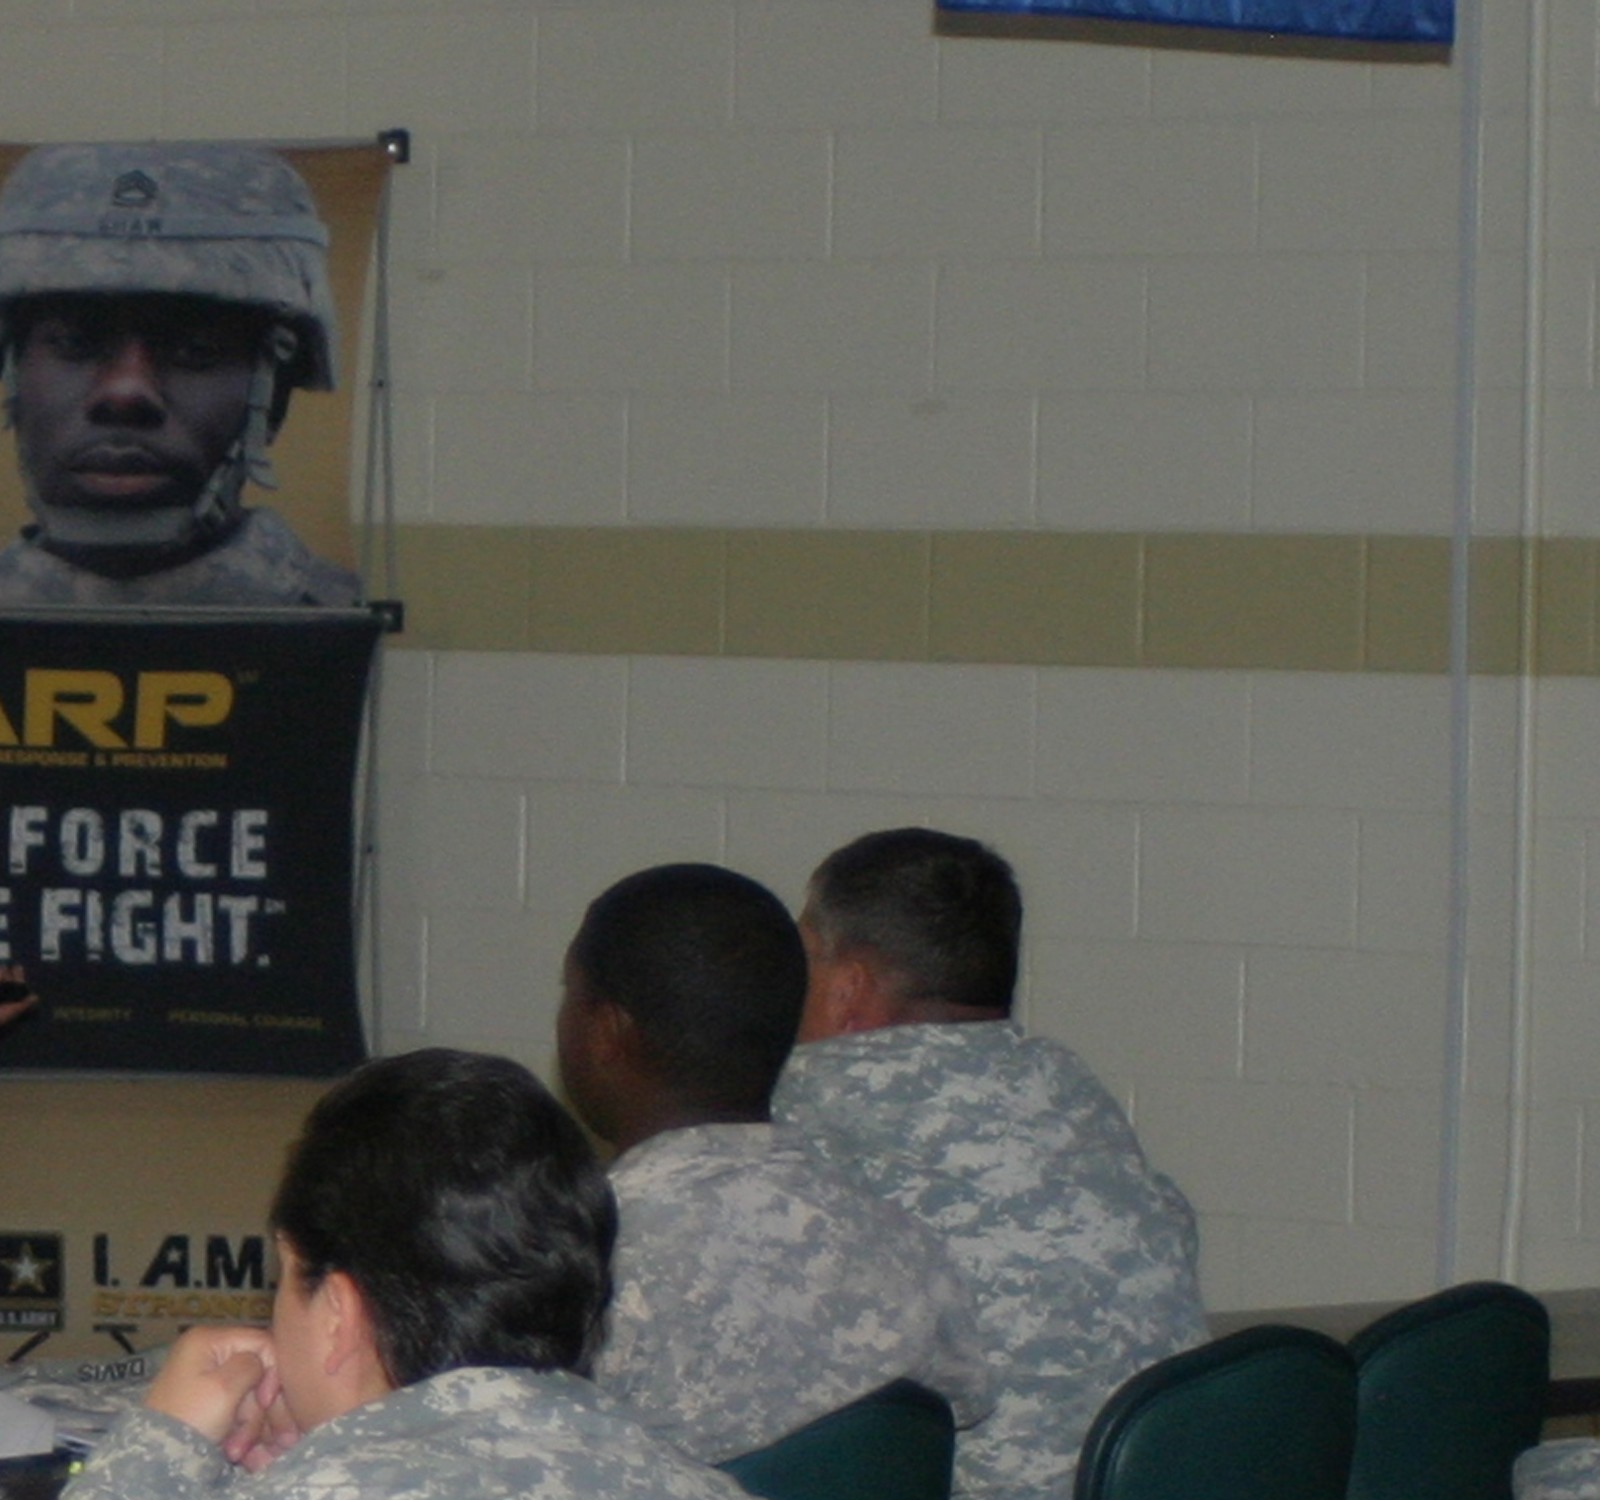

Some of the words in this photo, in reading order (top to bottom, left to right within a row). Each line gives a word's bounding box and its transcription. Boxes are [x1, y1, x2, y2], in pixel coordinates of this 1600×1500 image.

[111, 753, 229, 769] PREVENTION
[9, 805, 270, 880] FORCE
[39, 887, 271, 967] FIGHT.
[78, 1357, 146, 1383] DAVIS
